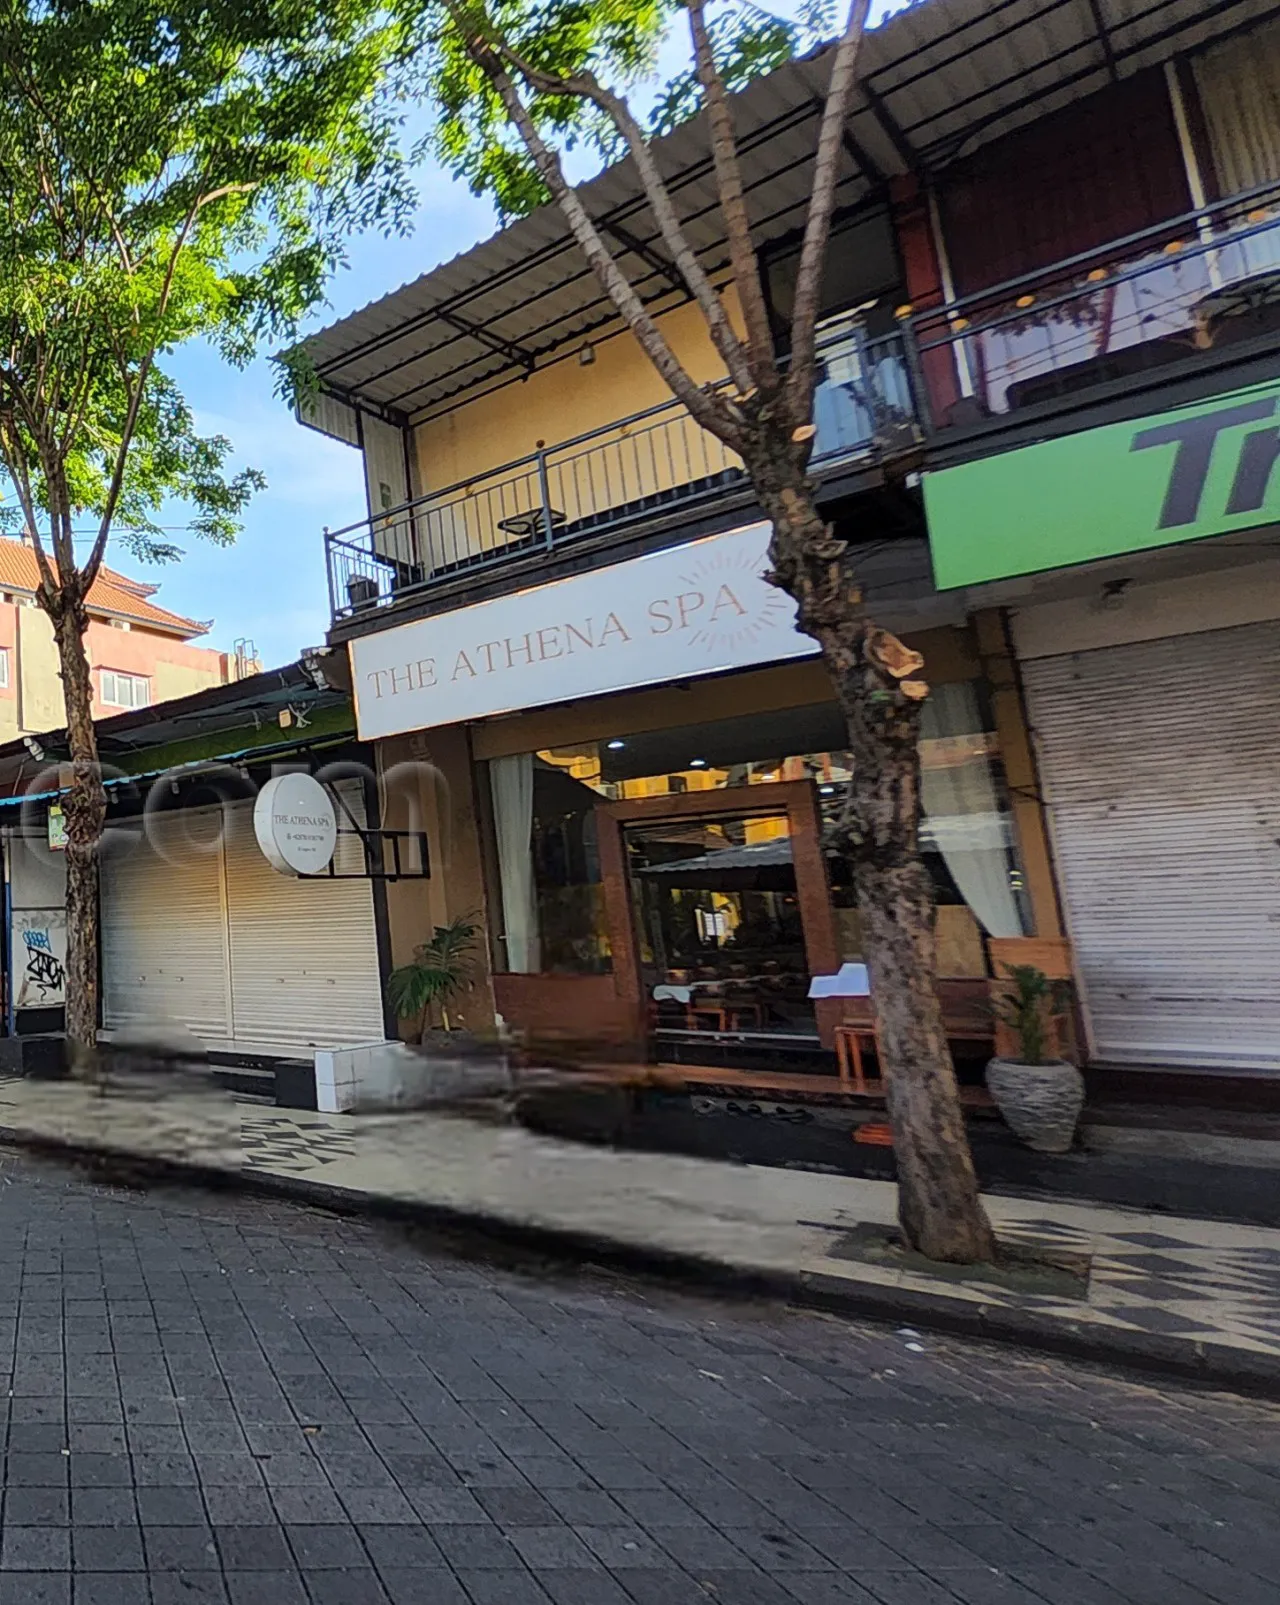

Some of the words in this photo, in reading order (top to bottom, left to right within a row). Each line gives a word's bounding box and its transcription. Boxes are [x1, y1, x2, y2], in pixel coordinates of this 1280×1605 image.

[366, 658, 438, 700] THE
[450, 611, 632, 682] ATHENA
[648, 583, 748, 636] SPA
[273, 814, 288, 825] THE
[290, 815, 317, 826] ATHENA
[318, 817, 329, 827] SPA
